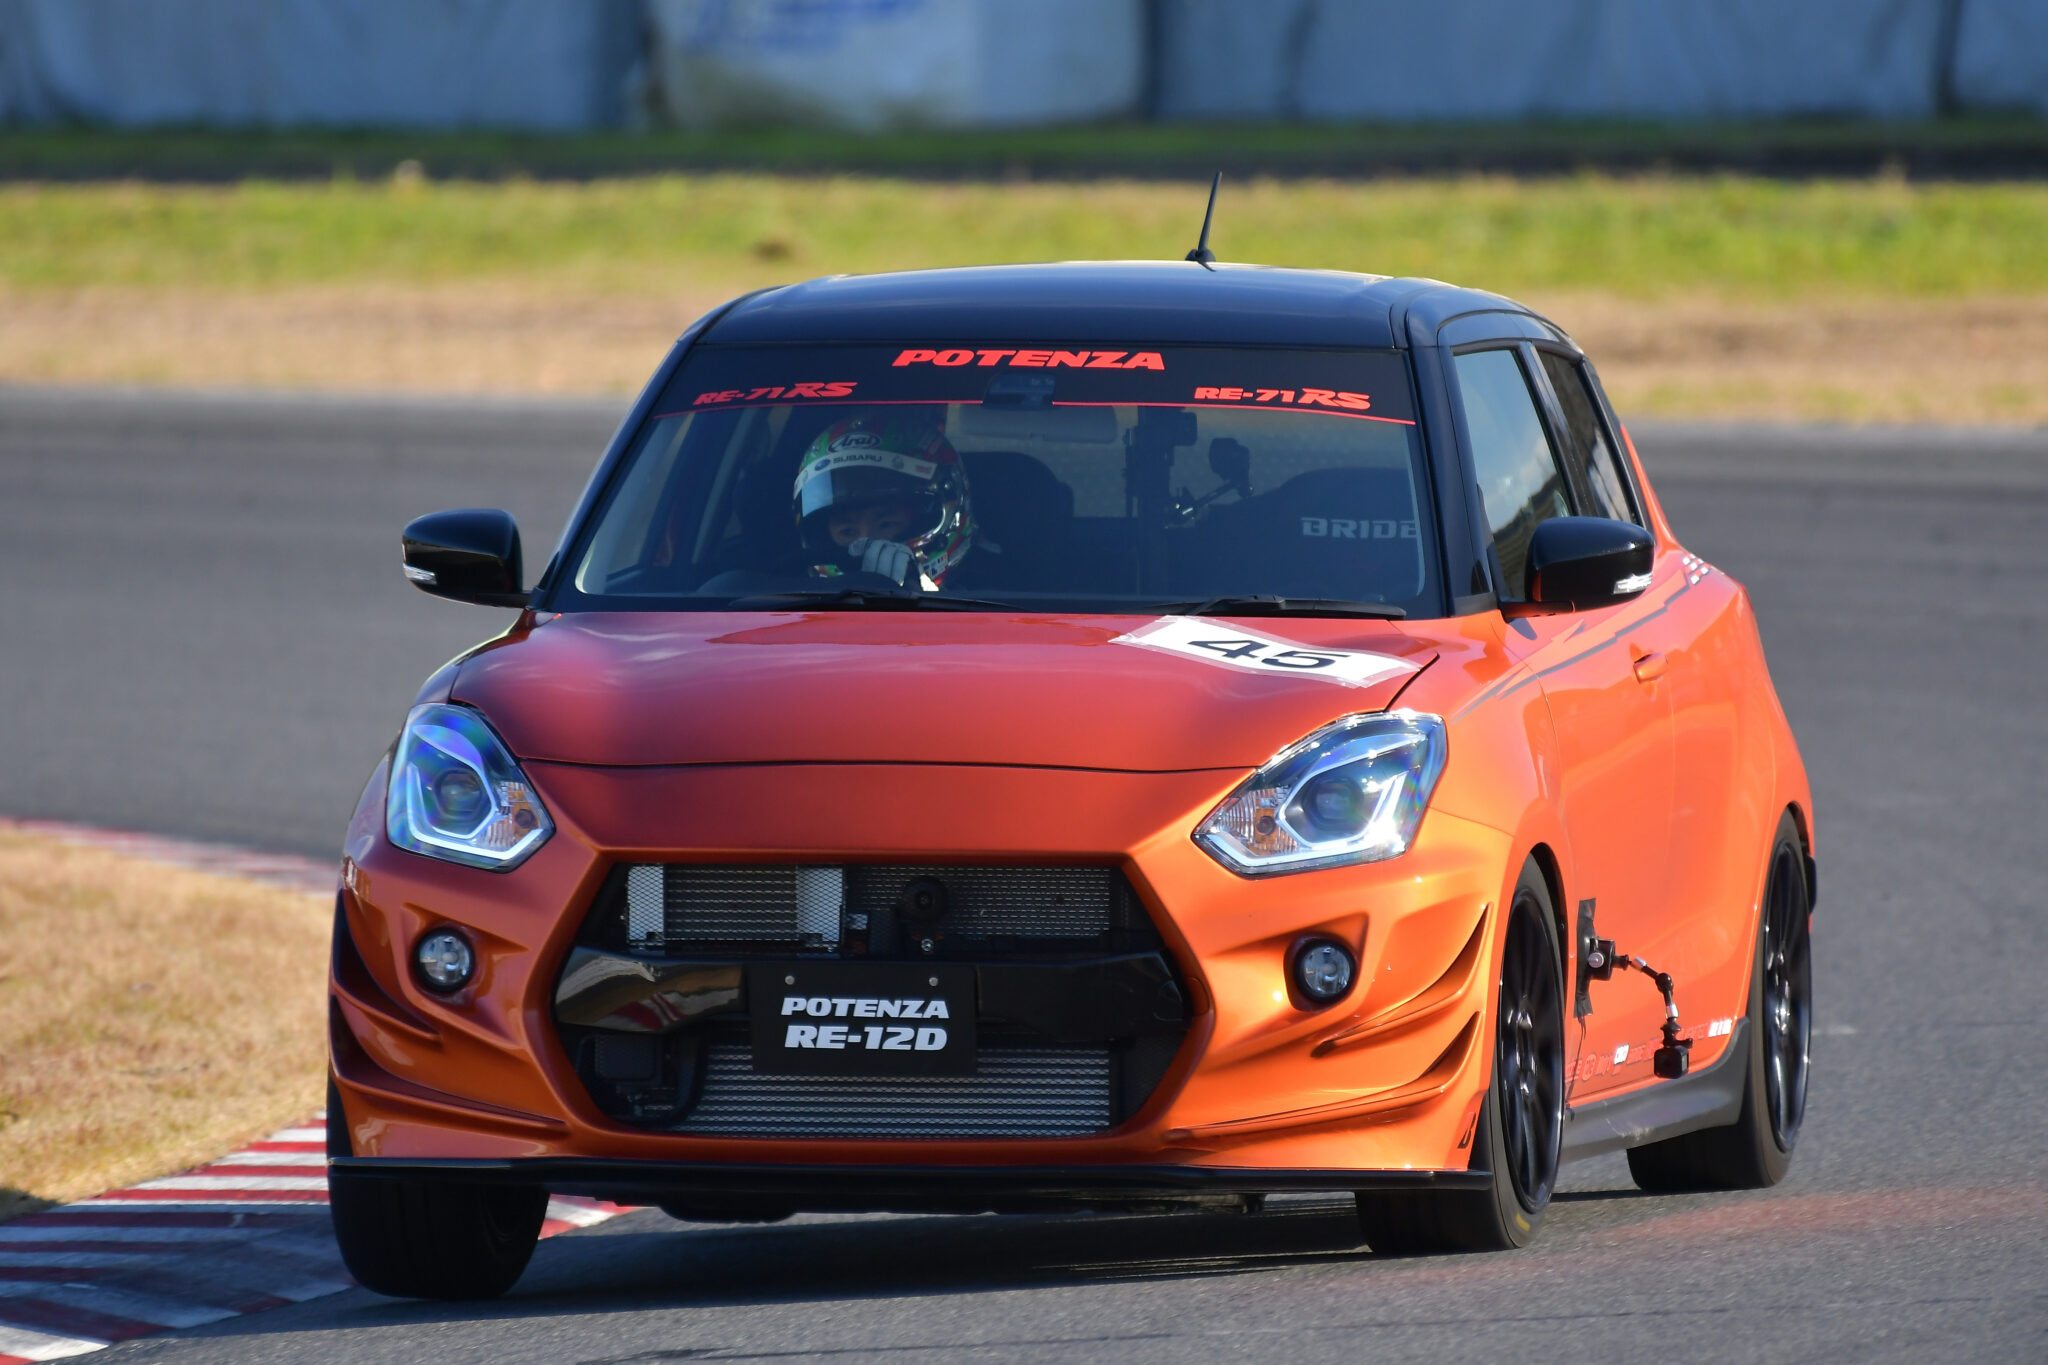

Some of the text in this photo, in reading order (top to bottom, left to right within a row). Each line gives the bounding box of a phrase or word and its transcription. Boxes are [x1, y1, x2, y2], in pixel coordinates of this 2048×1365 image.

[891, 349, 1165, 370] POTENZA
[833, 454, 882, 464] SUBARU
[1301, 516, 1418, 540] BRIDE
[1187, 639, 1350, 669] 45
[780, 997, 950, 1019] POTENZA
[784, 1025, 948, 1051] RE-12D
